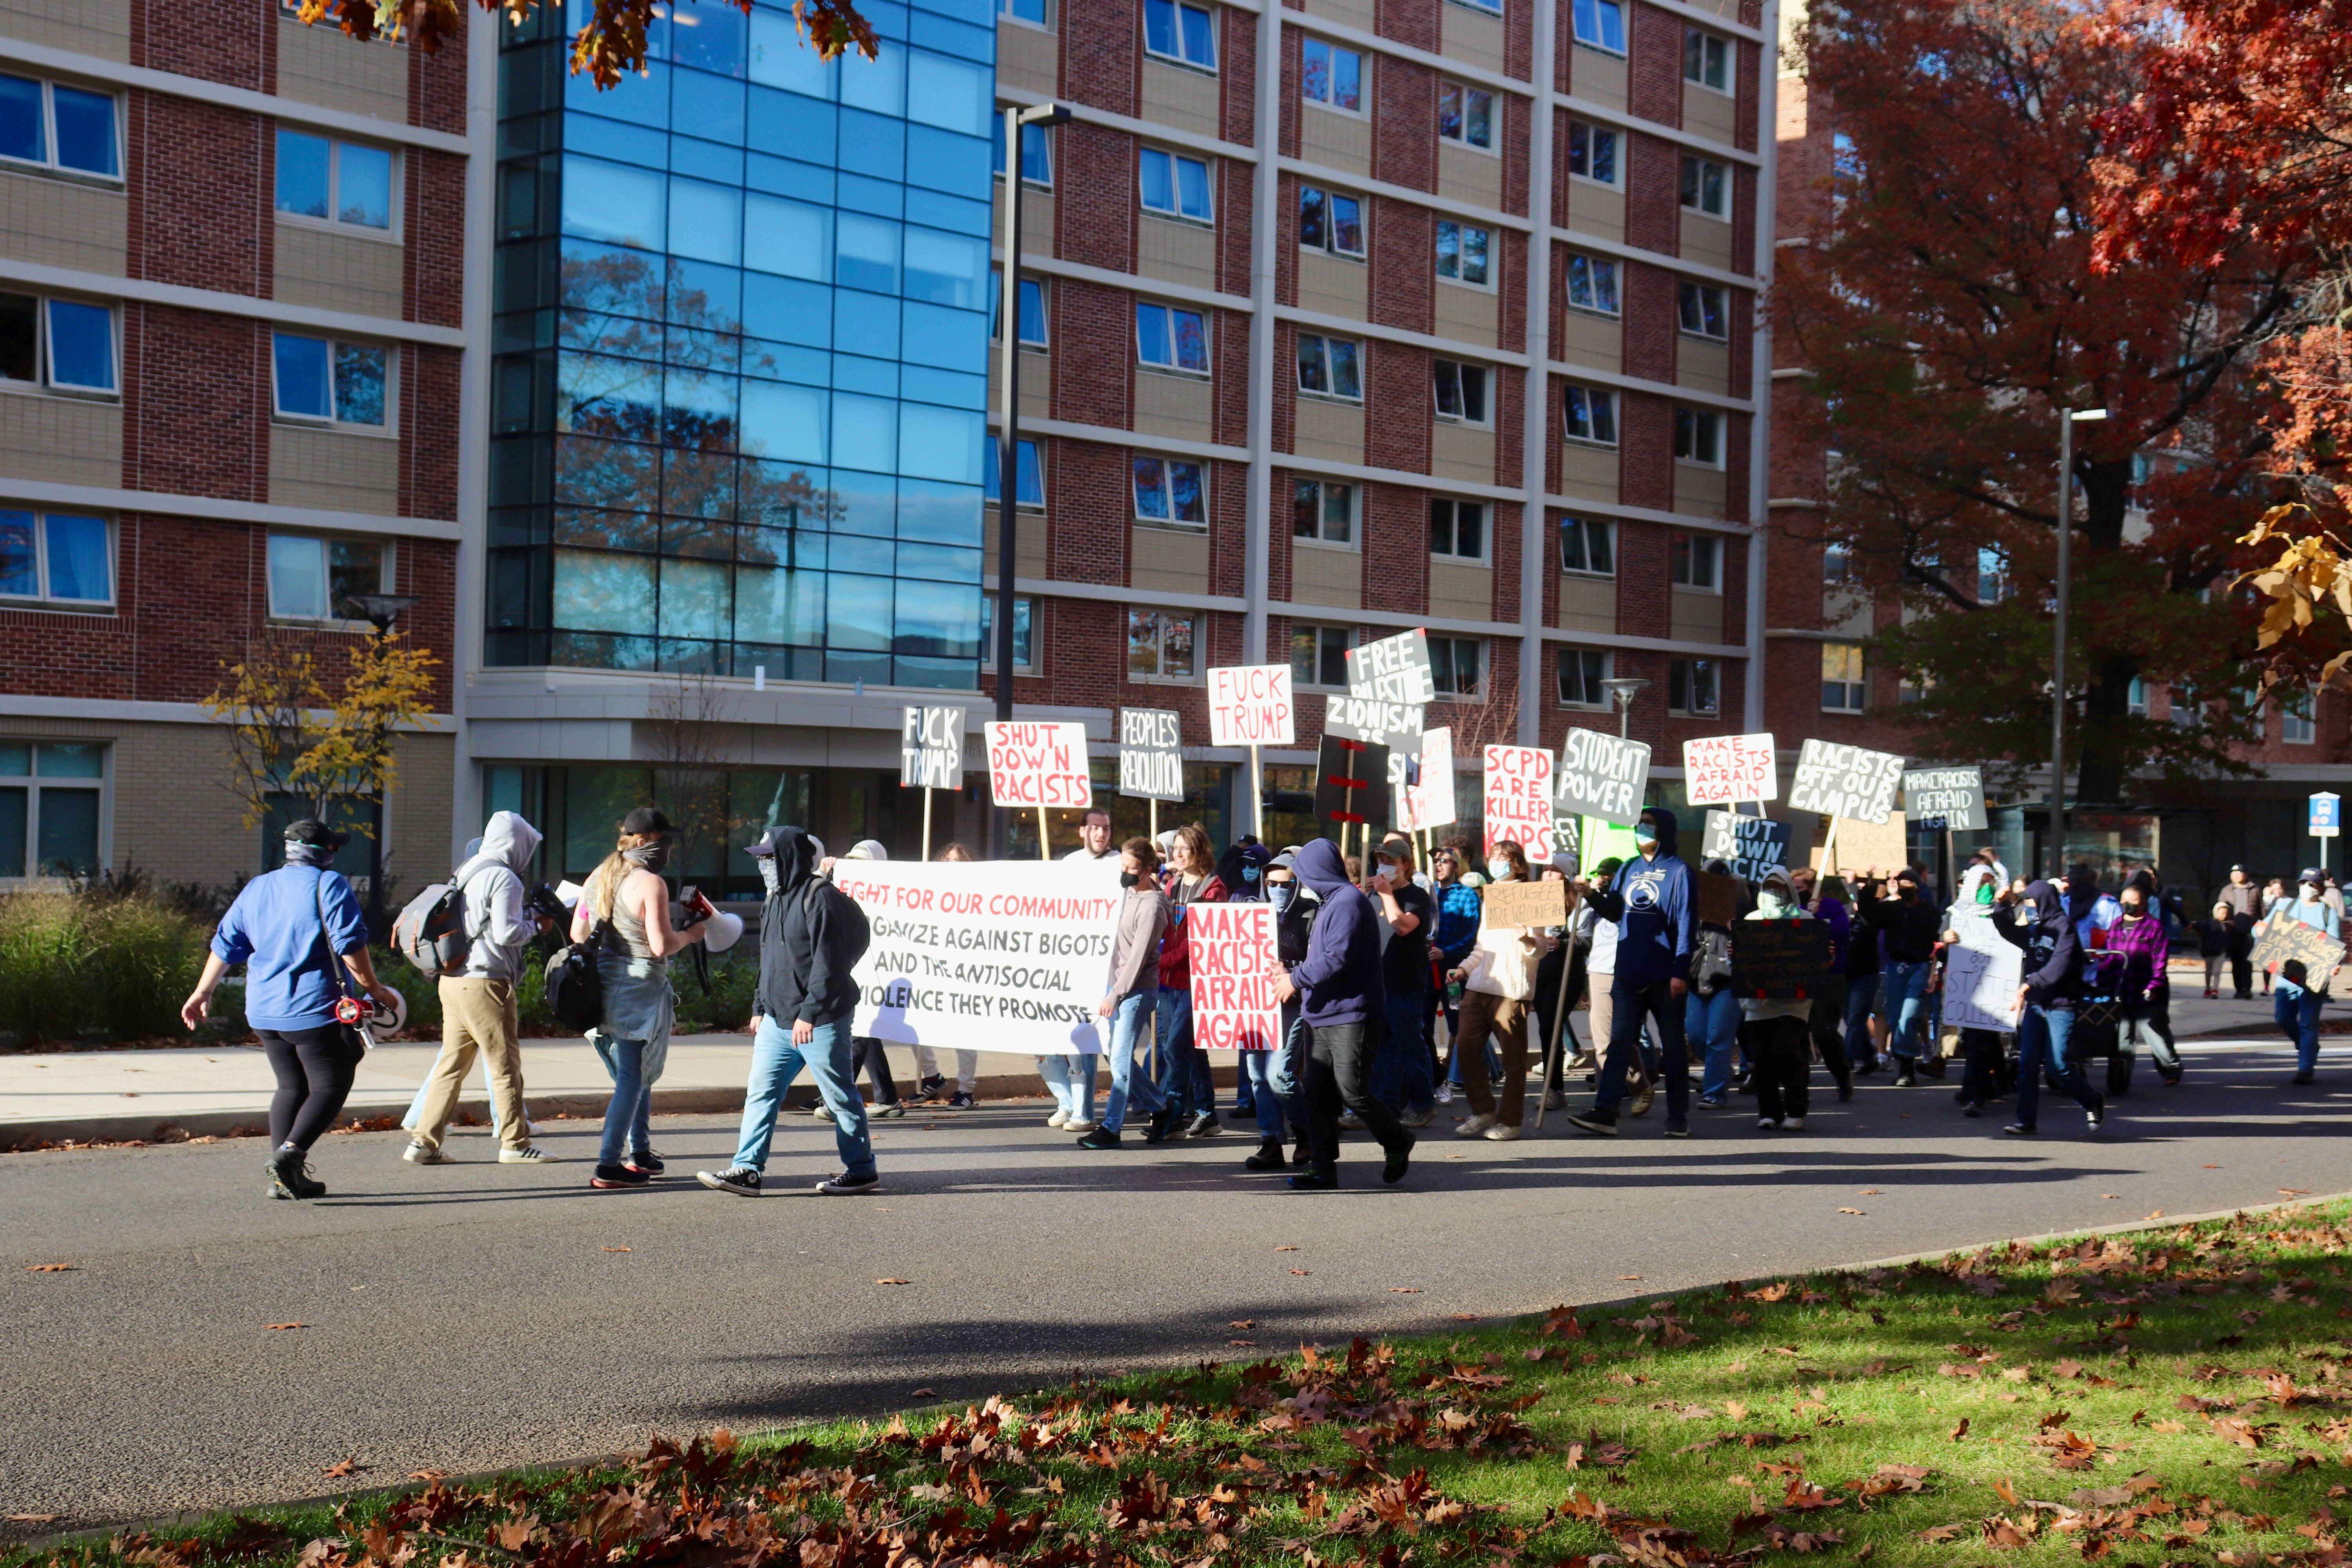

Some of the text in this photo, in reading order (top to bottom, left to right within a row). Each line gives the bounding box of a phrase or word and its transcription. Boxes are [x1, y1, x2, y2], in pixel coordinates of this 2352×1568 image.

[1356, 633, 1415, 680] FREE
[1219, 670, 1283, 701] FUCK
[905, 707, 958, 751] FUCK
[1122, 711, 1176, 748] PEOPLES
[1216, 703, 1288, 740] TRUMP
[1328, 696, 1423, 737] ZIONISM
[996, 724, 1060, 748] SHUT
[1689, 737, 1744, 753] MAKE
[902, 748, 958, 789] TRUMP
[993, 745, 1069, 771] DOWN
[1121, 750, 1183, 796] REVOLUTION
[1486, 748, 1550, 779] SCPD
[1567, 730, 1646, 784] STUDENT
[1690, 750, 1770, 770] RACISTS
[1805, 739, 1903, 783] RACISTS
[994, 772, 1088, 806] RACISTS
[1490, 777, 1542, 798] ARE
[1696, 766, 1765, 783] AFRAID
[1797, 764, 1893, 804] OFF OUR
[1559, 771, 1633, 817] POWER
[1693, 781, 1760, 802] AGAIN
[1791, 785, 1891, 825] CAMPUS
[1917, 790, 1973, 811] AFRAID
[1486, 797, 1550, 824] KILLER
[1920, 809, 1969, 830] AGAIN
[1711, 812, 1777, 842] SHUT
[1841, 834, 1857, 846] NO
[1716, 831, 1784, 864] DOWN
[897, 887, 934, 911] FOR
[940, 892, 982, 914] OUR
[989, 894, 1117, 920] COMMUNITY
[1487, 884, 1564, 905] REFUGEES
[1187, 906, 1269, 940] MAKE
[1489, 906, 1510, 926] ARE
[1953, 917, 2005, 941] FASCI
[865, 916, 1111, 956] GANIZE AGAINST BIGOTS
[1974, 944, 1994, 955] GET
[875, 951, 1072, 992] AND THE ANTISOCIAL
[1189, 939, 1276, 976] RACISTS
[1970, 955, 1991, 964] OUT
[1194, 975, 1279, 1011] AFRAID
[1948, 970, 2018, 1002] STATE
[949, 993, 994, 1016] THEY
[1000, 997, 1092, 1024] PROMOTE
[1945, 1000, 2017, 1029] COLLEGE
[1194, 1013, 1278, 1050] AGAIN
